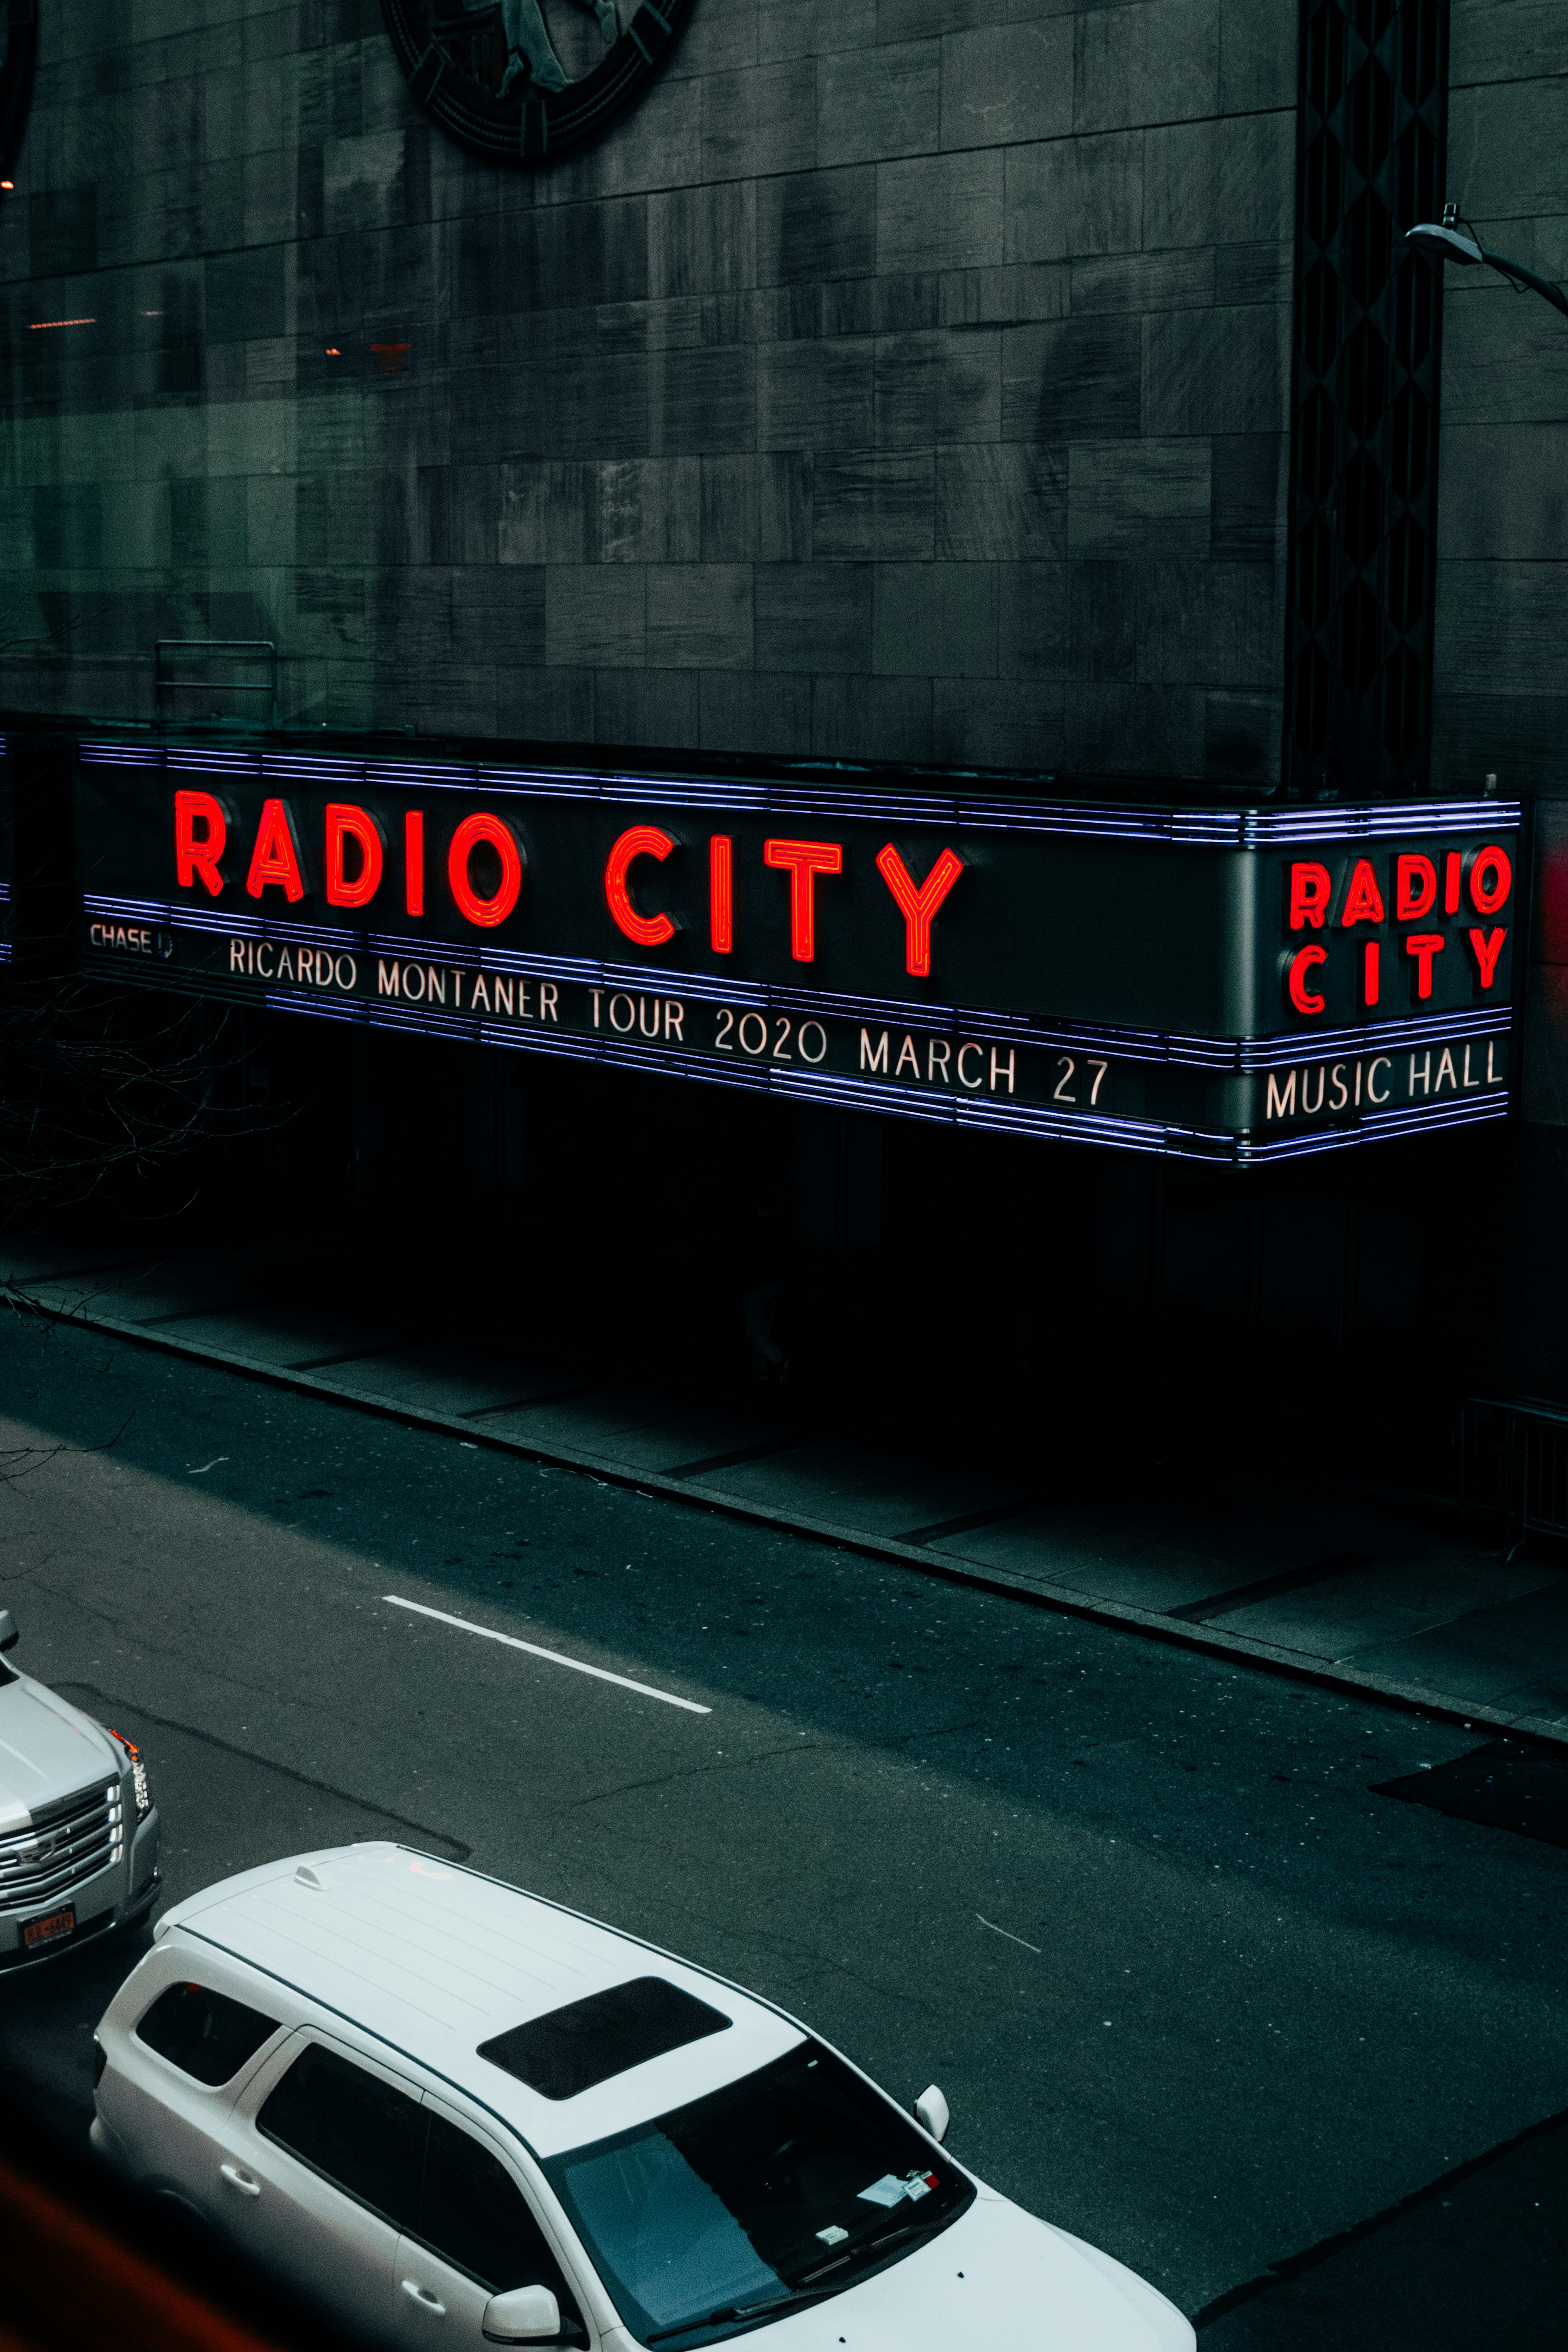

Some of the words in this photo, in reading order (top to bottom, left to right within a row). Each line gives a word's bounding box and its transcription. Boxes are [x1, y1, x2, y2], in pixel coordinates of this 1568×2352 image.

[174, 789, 522, 928] RADIO
[605, 824, 963, 977] CITY
[1290, 845, 1512, 930] RADIO
[90, 923, 152, 954] CHASE
[1289, 927, 1508, 1015] CITY
[229, 938, 357, 991] RICARDO
[377, 961, 558, 1022] MONTANER
[587, 988, 684, 1042] TOUR
[714, 1008, 827, 1063] 2020
[859, 1028, 1015, 1094] MARCH
[1052, 1055, 1108, 1106] 27
[1266, 1057, 1392, 1119] MUSIC
[1408, 1040, 1503, 1097] HALL
